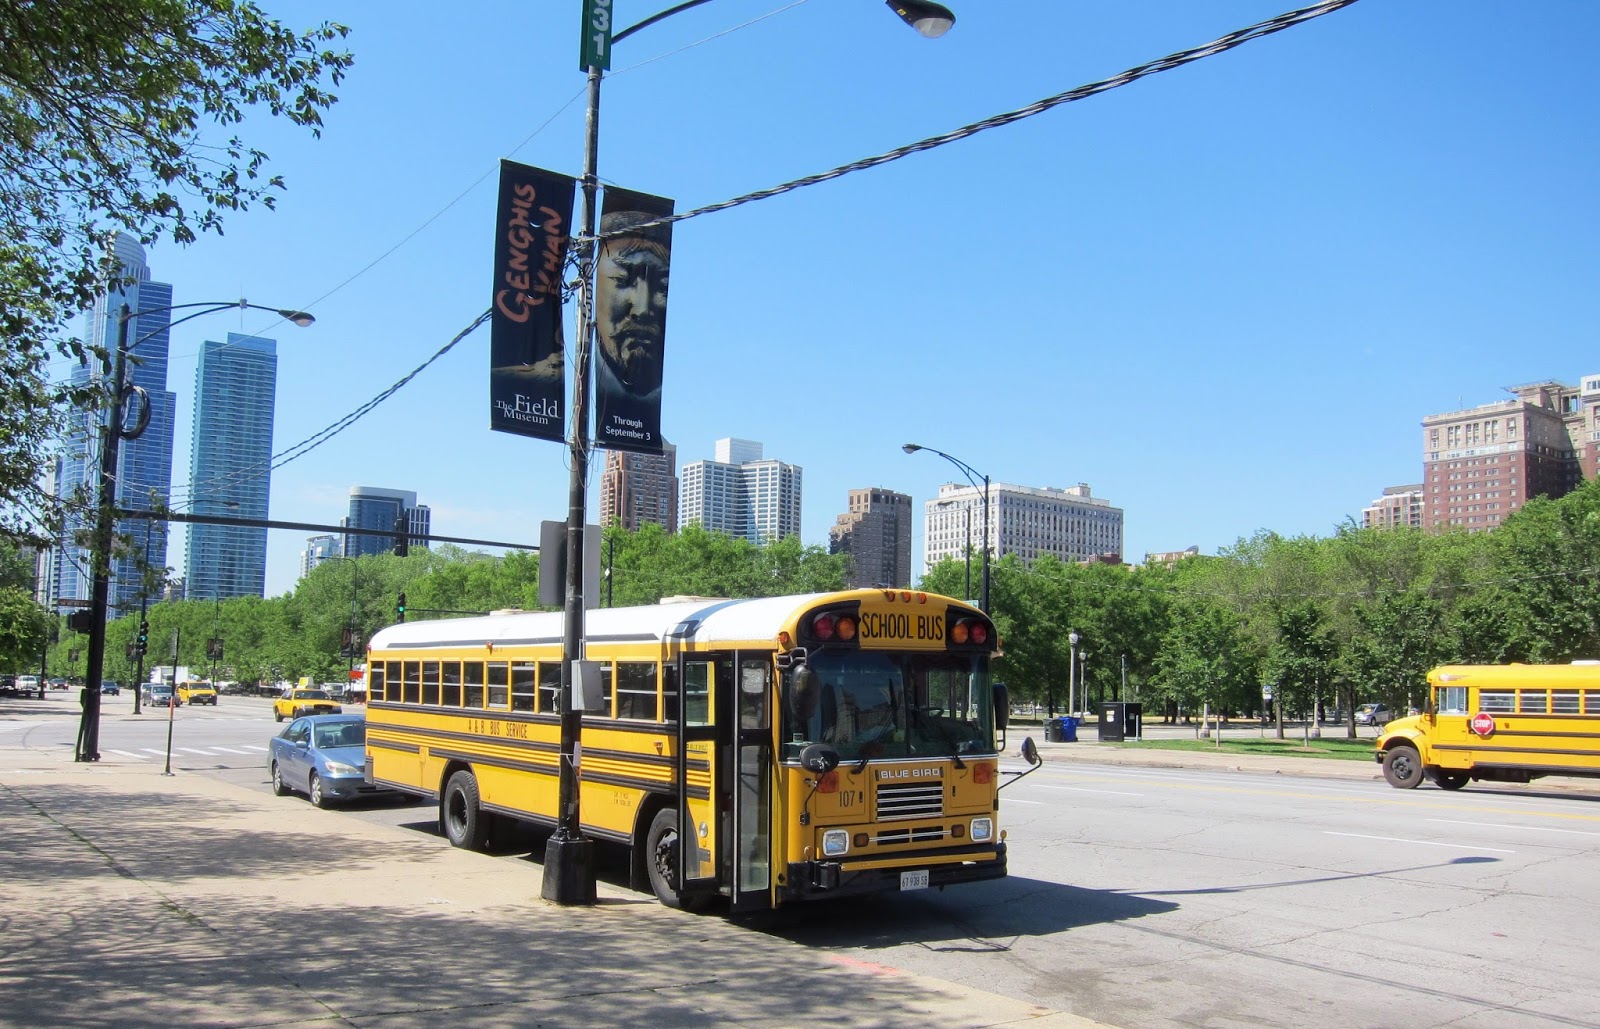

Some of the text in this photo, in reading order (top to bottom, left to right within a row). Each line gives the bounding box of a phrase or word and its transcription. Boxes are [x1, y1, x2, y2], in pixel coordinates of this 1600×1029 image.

[497, 183, 536, 323] GENGHIS
[526, 206, 567, 306] KHAN
[496, 394, 559, 418] The Field
[503, 408, 549, 425] Museum
[613, 415, 643, 429] Through
[605, 425, 651, 441] September 3
[861, 612, 944, 641] SCHOOL BUS
[490, 721, 500, 736] BUS
[506, 722, 528, 739] SERVICE
[1474, 719, 1491, 728] STOP
[880, 768, 940, 779] BLUE BIRD
[839, 790, 855, 808] 107
